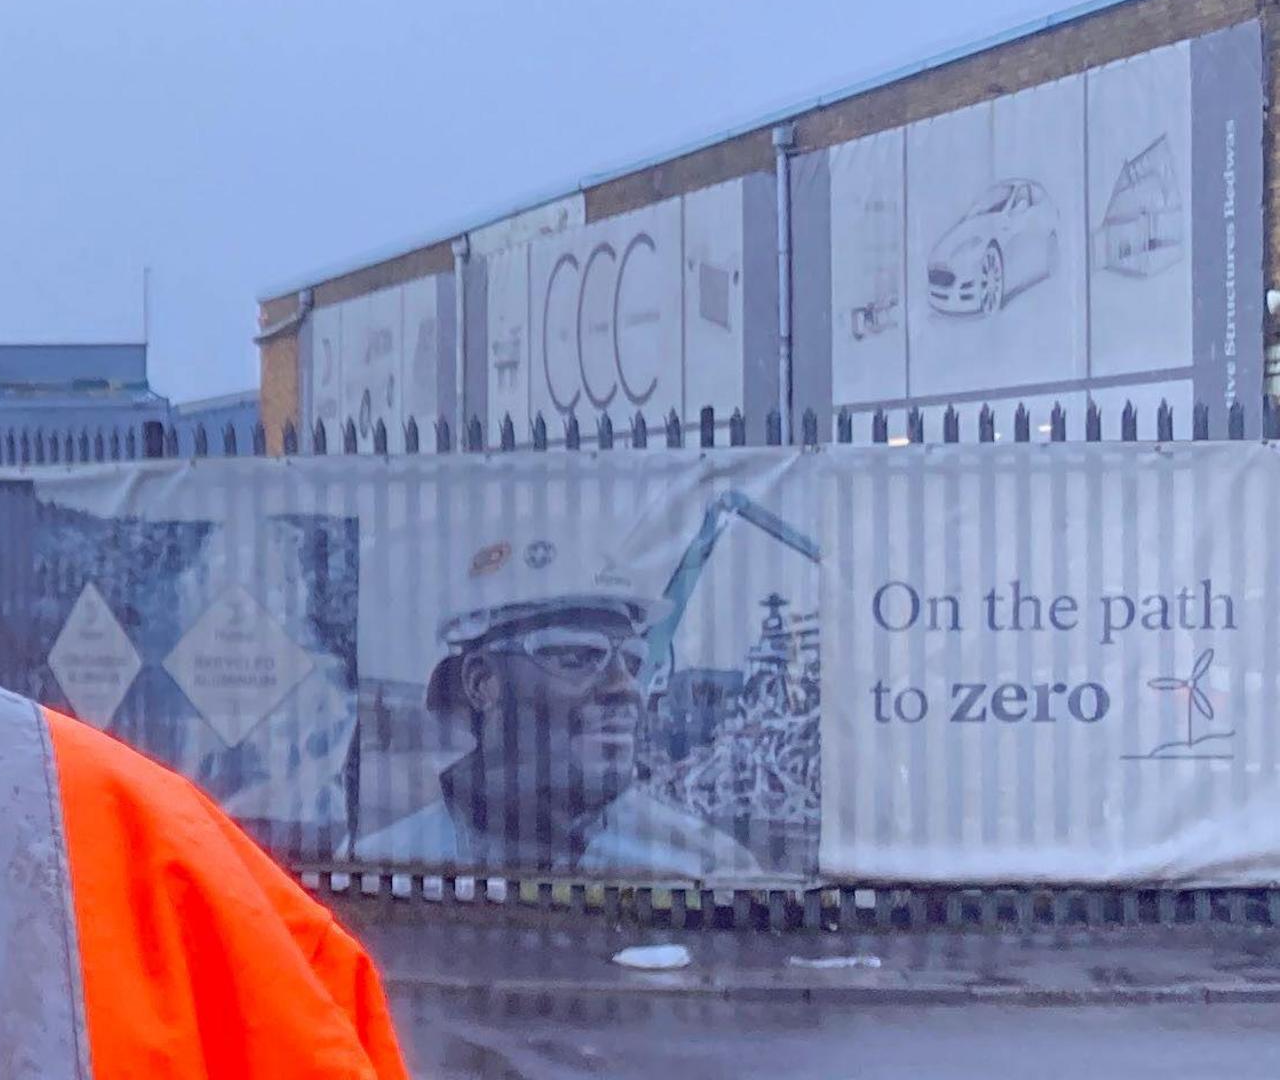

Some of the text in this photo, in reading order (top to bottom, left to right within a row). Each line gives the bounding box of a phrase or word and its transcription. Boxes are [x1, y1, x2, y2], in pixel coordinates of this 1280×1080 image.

[1224, 224, 1237, 357] Structures
[872, 579, 1239, 646] On the path
[870, 680, 1111, 724] to zero
